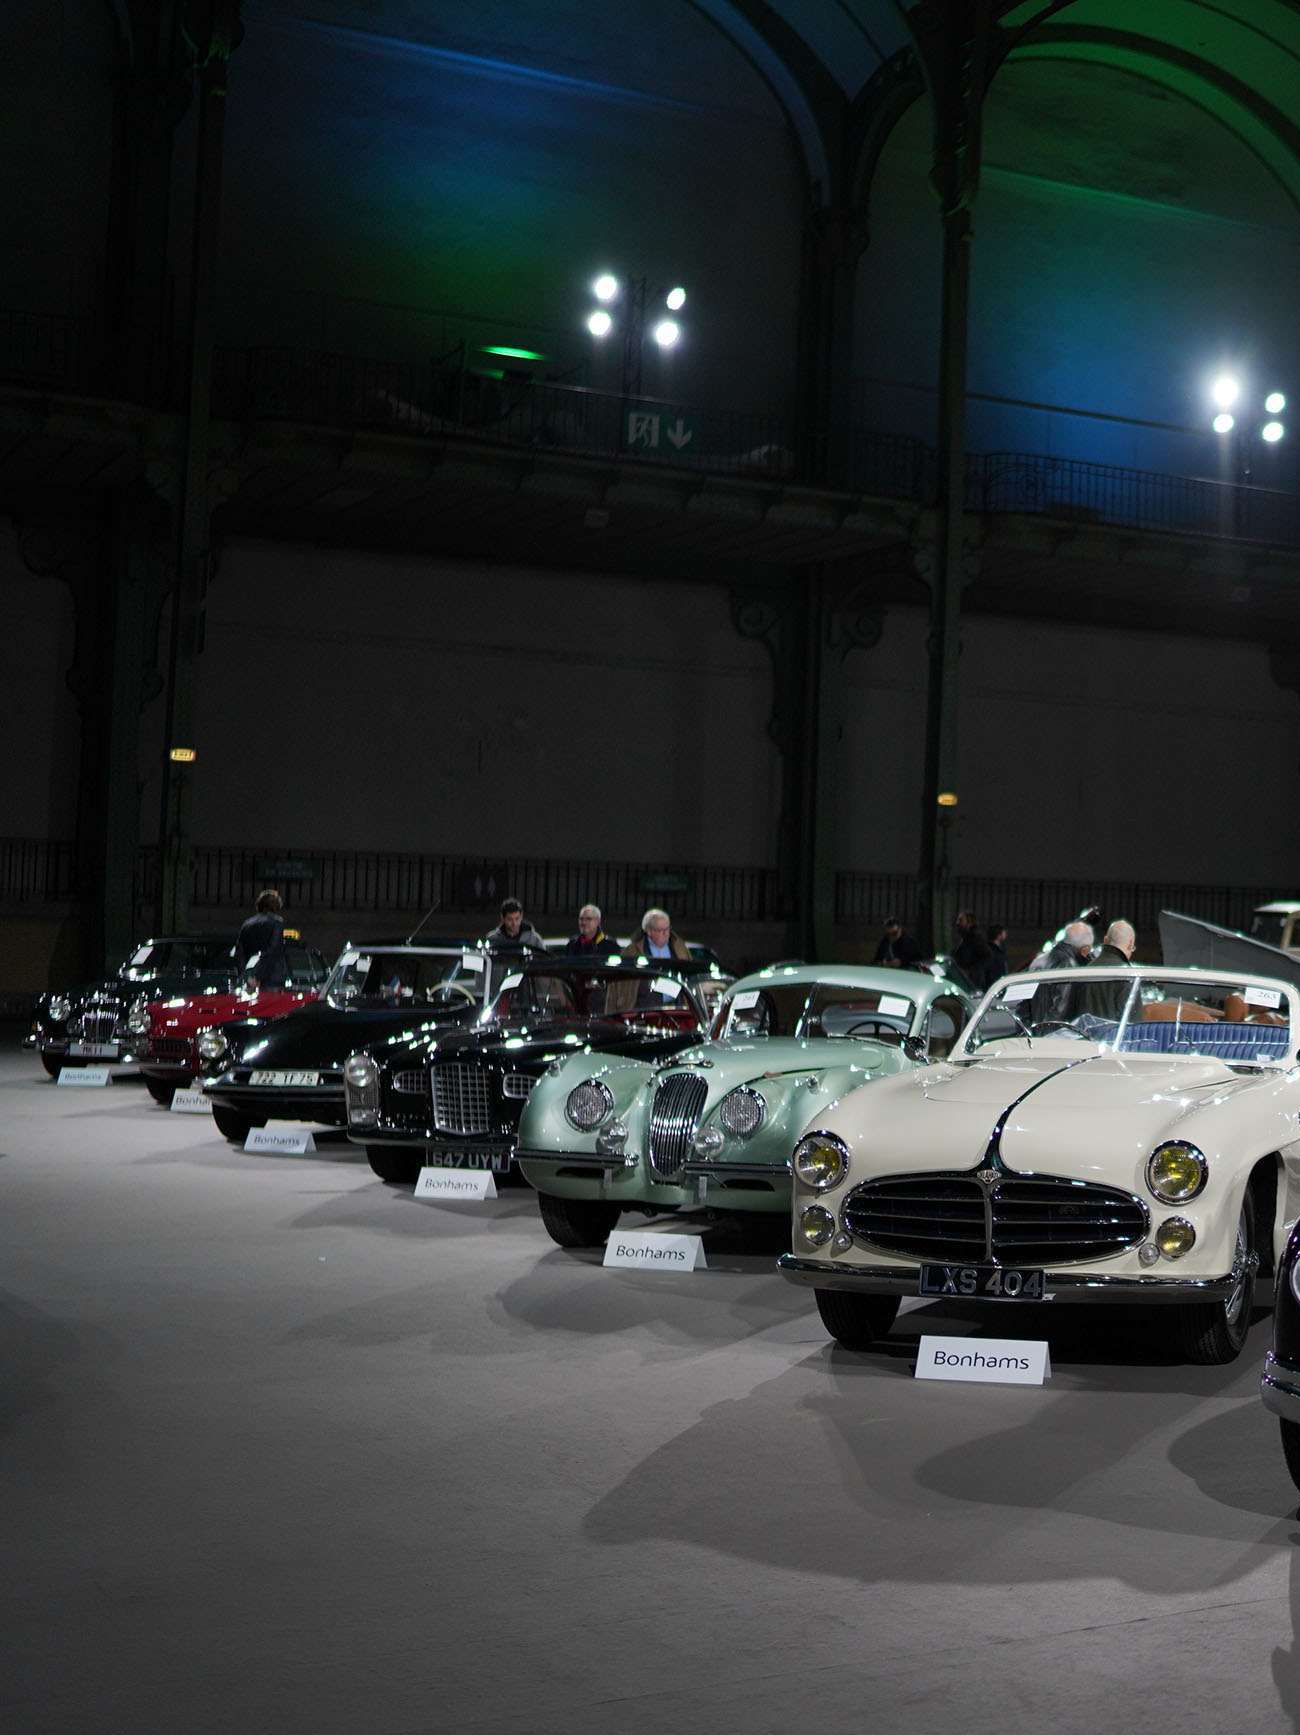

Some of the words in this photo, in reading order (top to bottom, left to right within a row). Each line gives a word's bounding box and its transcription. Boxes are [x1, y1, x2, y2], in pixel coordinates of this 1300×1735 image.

[253, 1135, 301, 1146] Bonhams
[468, 1152, 502, 1172] UYW
[424, 1178, 480, 1192] Bonhams
[616, 1245, 686, 1261] Bonhams
[923, 1266, 978, 1294] LXS
[985, 1270, 1041, 1297] 404
[933, 1350, 1030, 1370] Bonhams
